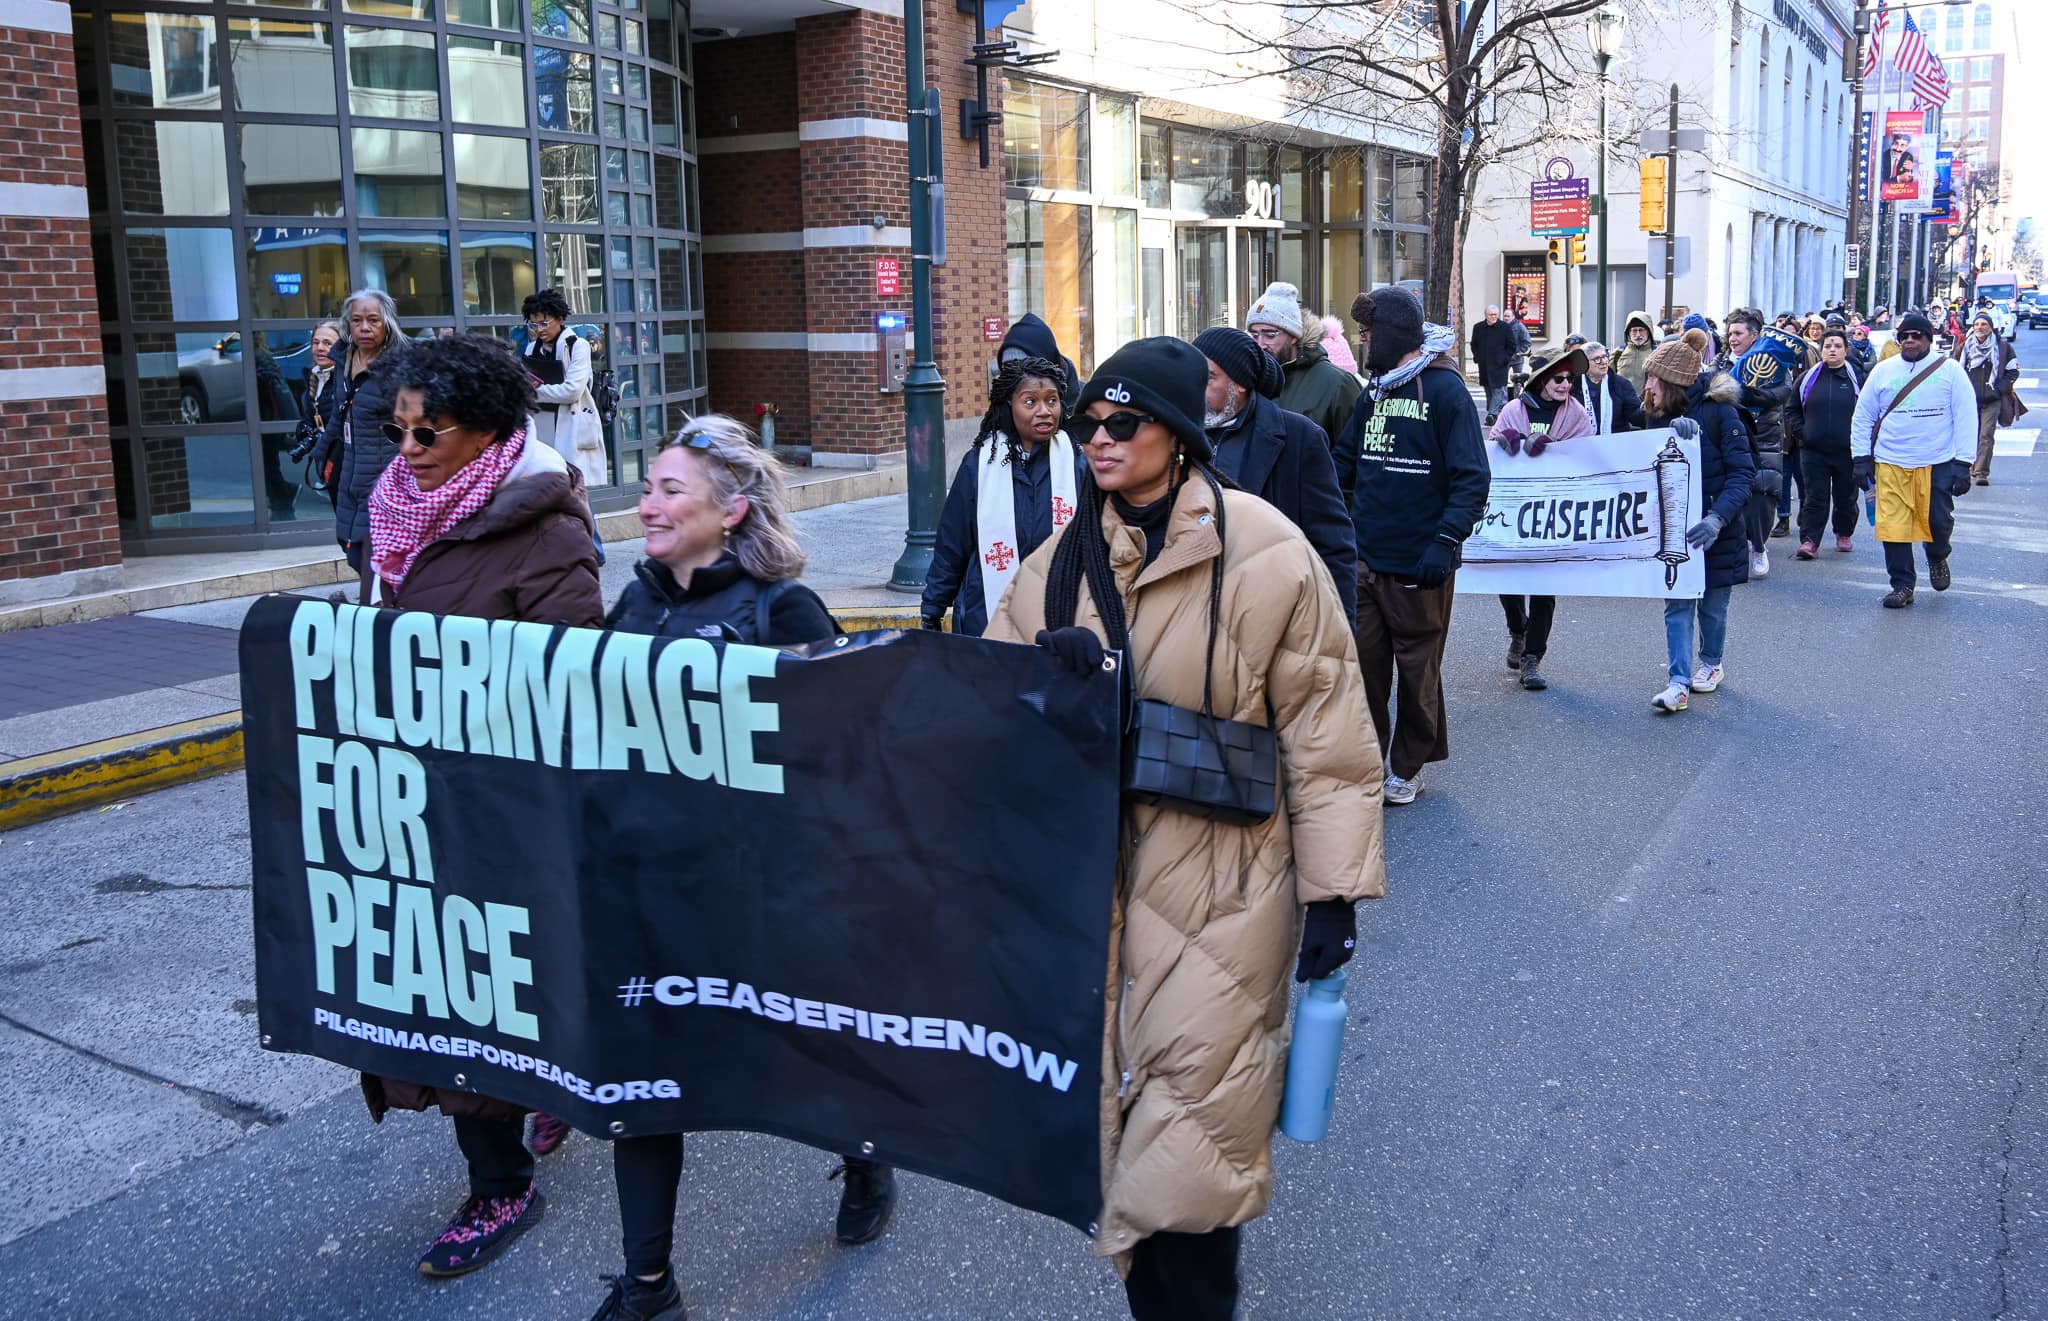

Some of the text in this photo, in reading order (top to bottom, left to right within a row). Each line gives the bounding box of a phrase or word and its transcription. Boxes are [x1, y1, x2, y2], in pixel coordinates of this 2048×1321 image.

[1246, 179, 1280, 219] 901
[878, 261, 896, 270] F.D.C.
[1104, 382, 1131, 403] alo
[1475, 490, 1649, 542] for CEASEFIRE
[290, 600, 784, 794] PILGRIMAGE
[297, 734, 434, 883] FOR
[306, 867, 539, 1041] PEACE
[314, 1007, 681, 1104] PILGRIMAGEFORPEACE.ORG
[617, 975, 1078, 1092] #CEASEFIRENOW
